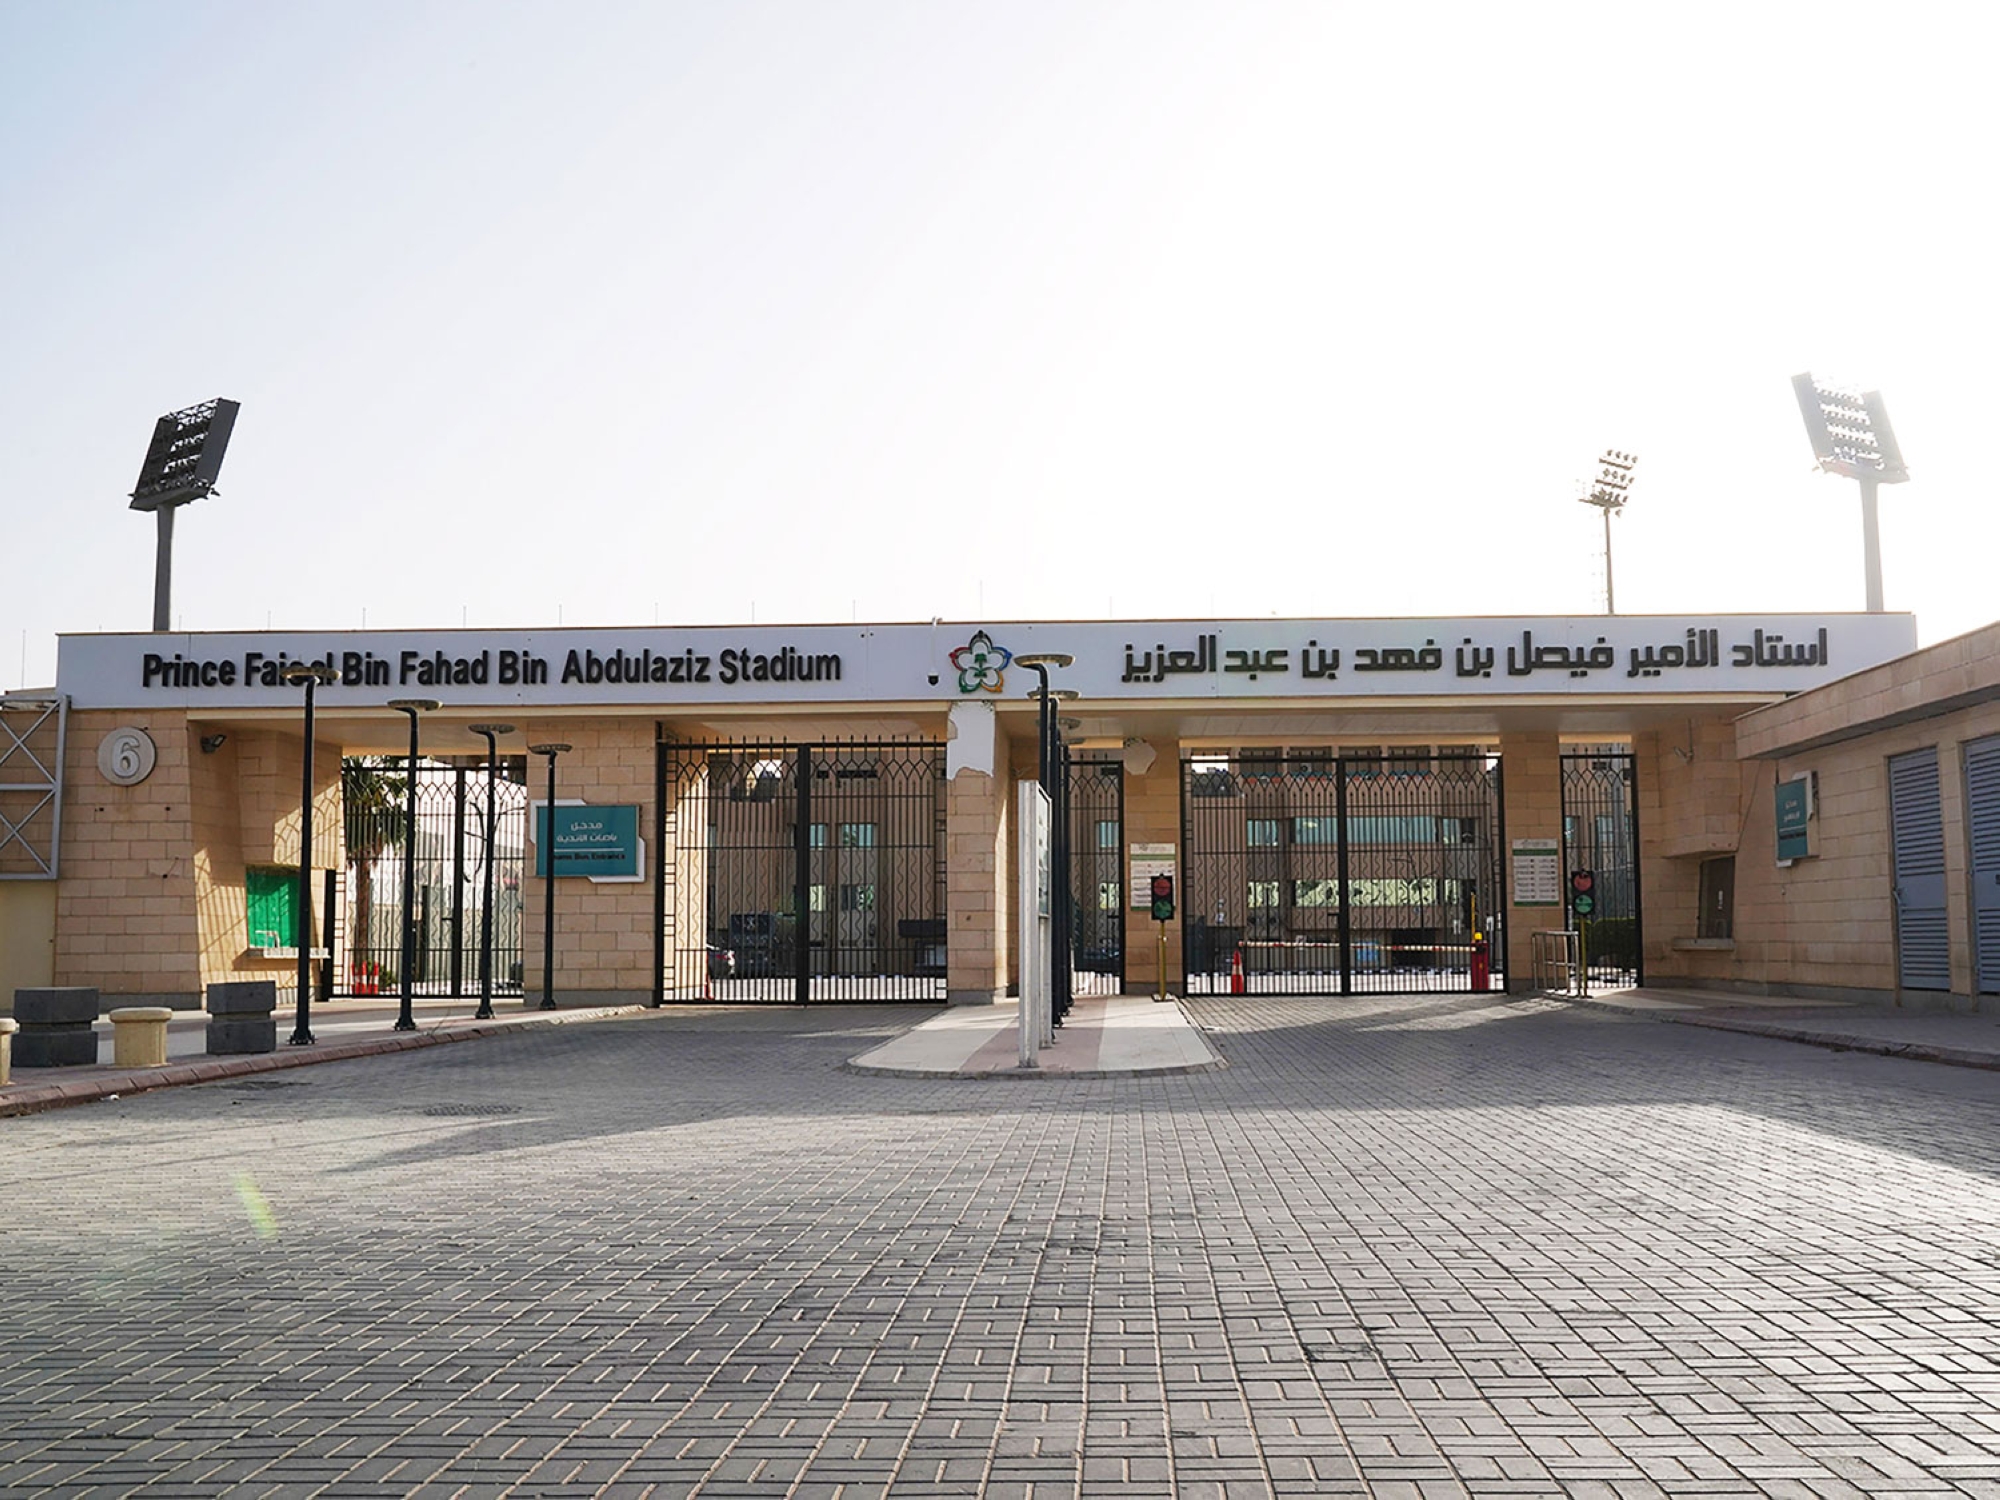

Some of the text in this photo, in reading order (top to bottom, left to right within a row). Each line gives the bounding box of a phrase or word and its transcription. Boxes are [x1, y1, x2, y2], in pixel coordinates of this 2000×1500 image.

[142, 653, 236, 688] Prince
[342, 651, 390, 686] Bin
[399, 650, 489, 685] Fahad
[499, 650, 548, 685] Bin
[561, 648, 711, 684] Abdulaziz
[718, 647, 841, 684] Stadium
[1121, 627, 1828, 683] استاد الأمير فيصل بن فهد بن عبد العزيز
[112, 735, 140, 778] 6
